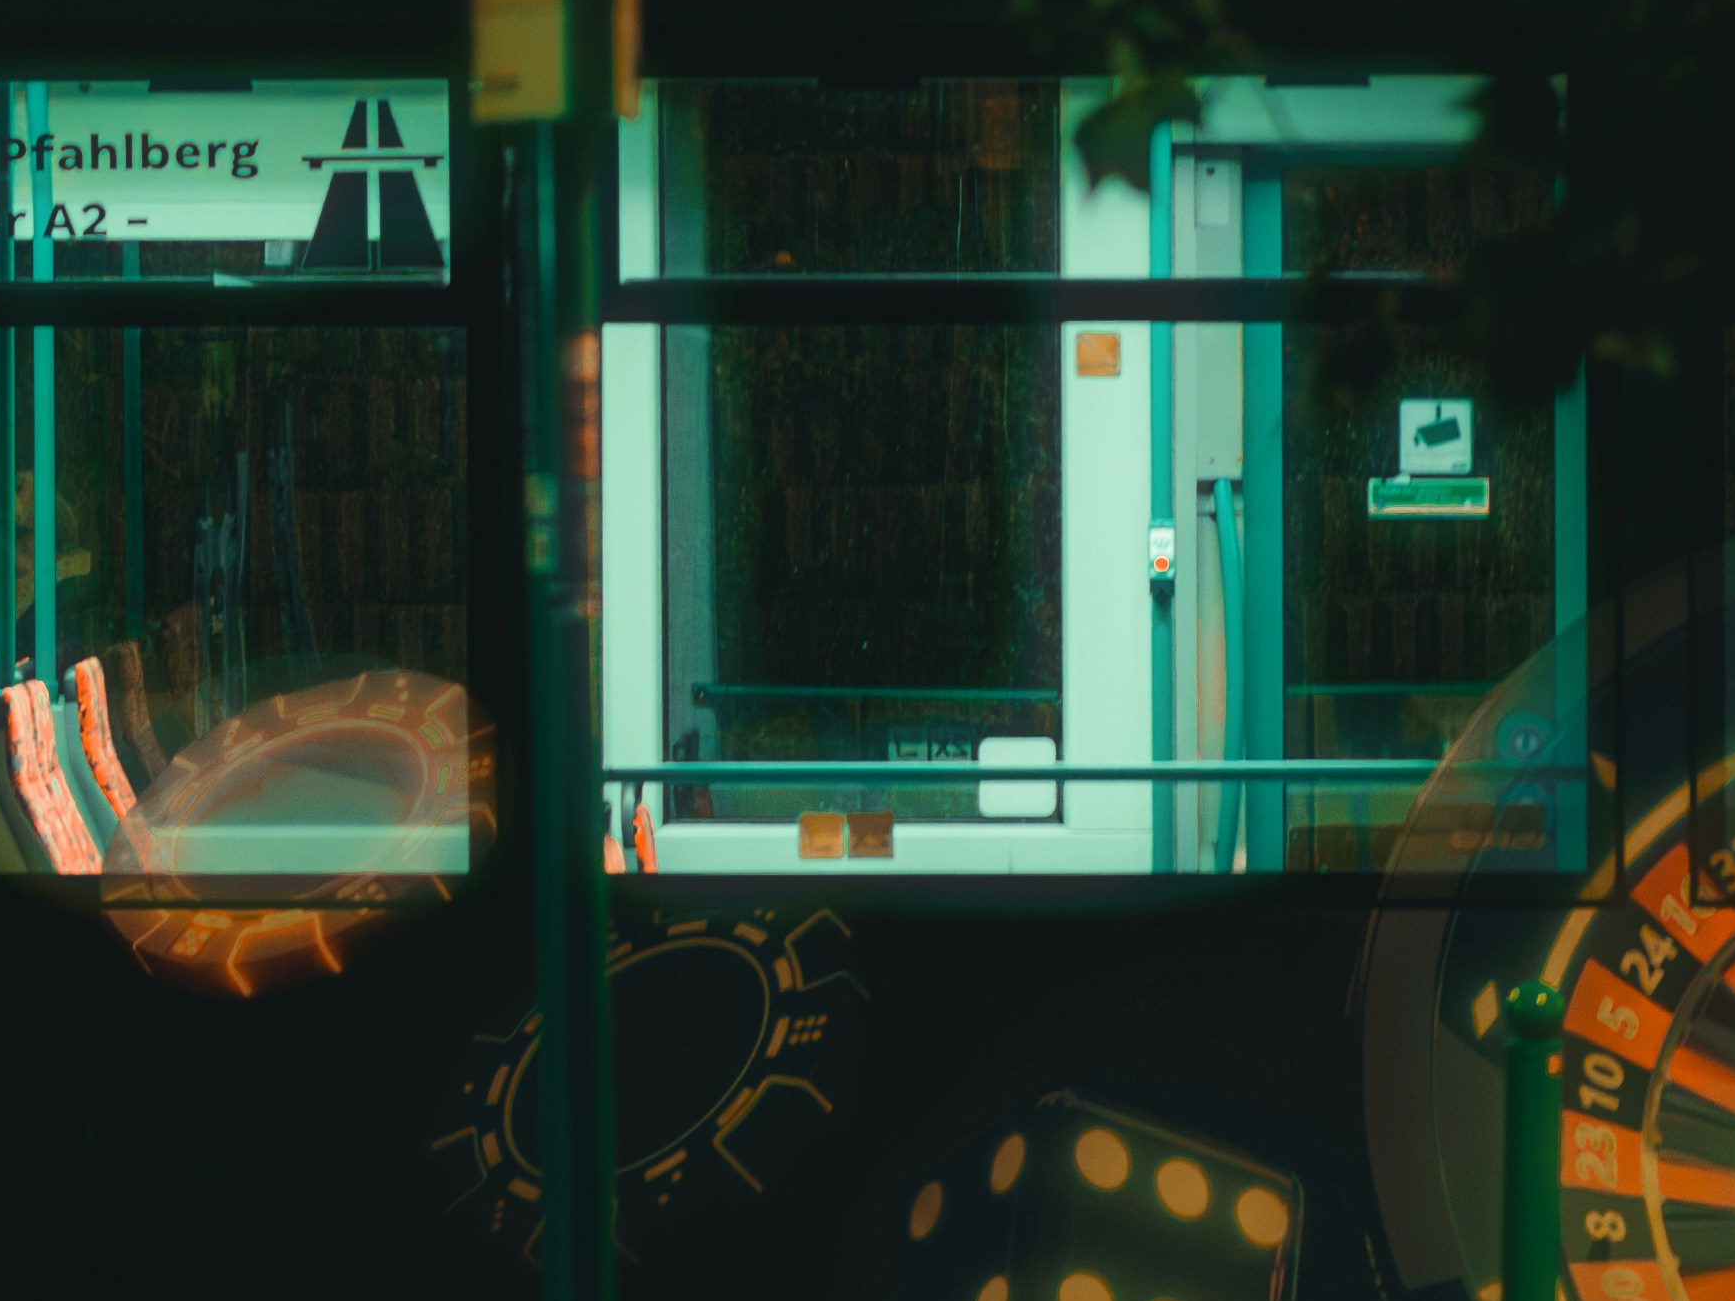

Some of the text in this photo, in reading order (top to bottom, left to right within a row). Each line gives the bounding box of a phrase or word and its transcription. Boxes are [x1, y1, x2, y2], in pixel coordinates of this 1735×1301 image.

[42, 202, 108, 238] A2
[1619, 923, 1678, 997] 24
[1595, 994, 1641, 1041] 5
[1578, 1052, 1626, 1113] 10
[1573, 1121, 1620, 1190] 23
[1583, 1209, 1628, 1244] 8
